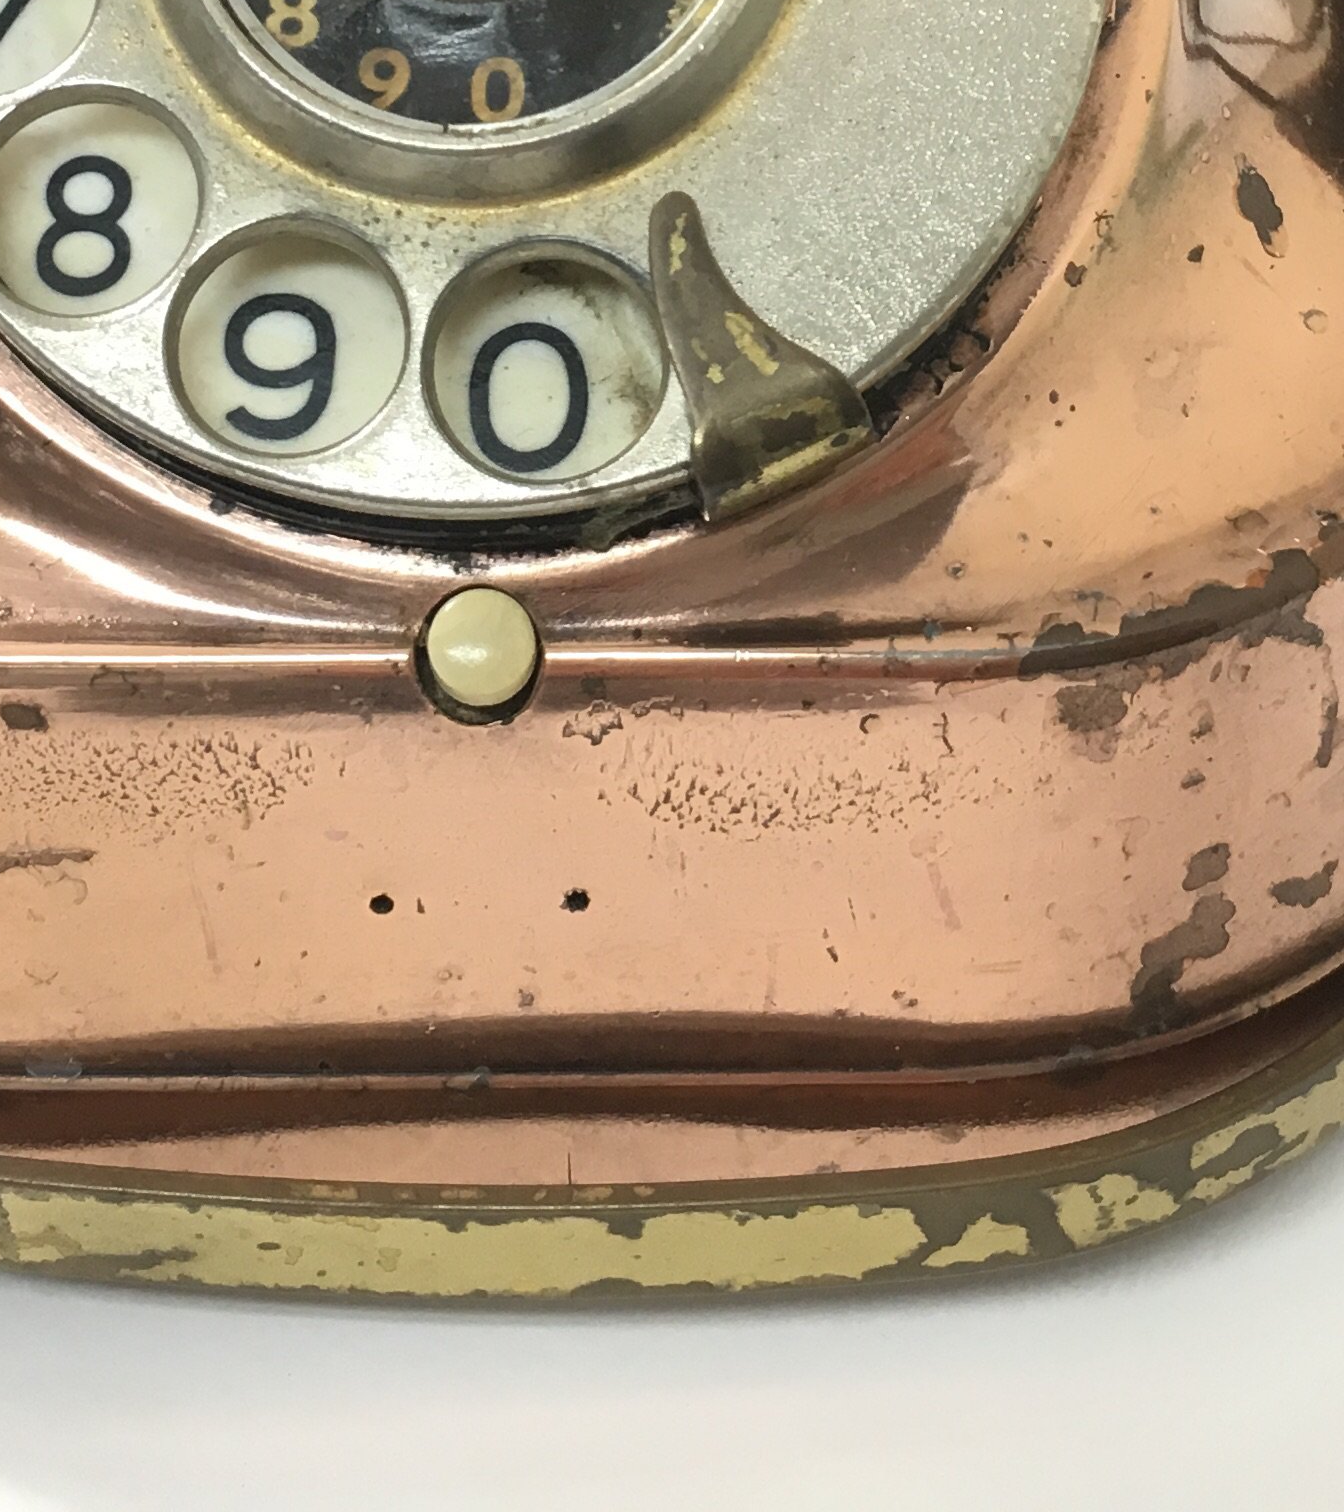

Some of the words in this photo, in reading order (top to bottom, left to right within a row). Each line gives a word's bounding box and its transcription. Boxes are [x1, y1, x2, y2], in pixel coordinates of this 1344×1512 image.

[359, 48, 411, 111] 9
[470, 56, 525, 123] 0
[35, 155, 134, 299] 8
[223, 292, 338, 442] 9
[468, 321, 590, 475] 0
